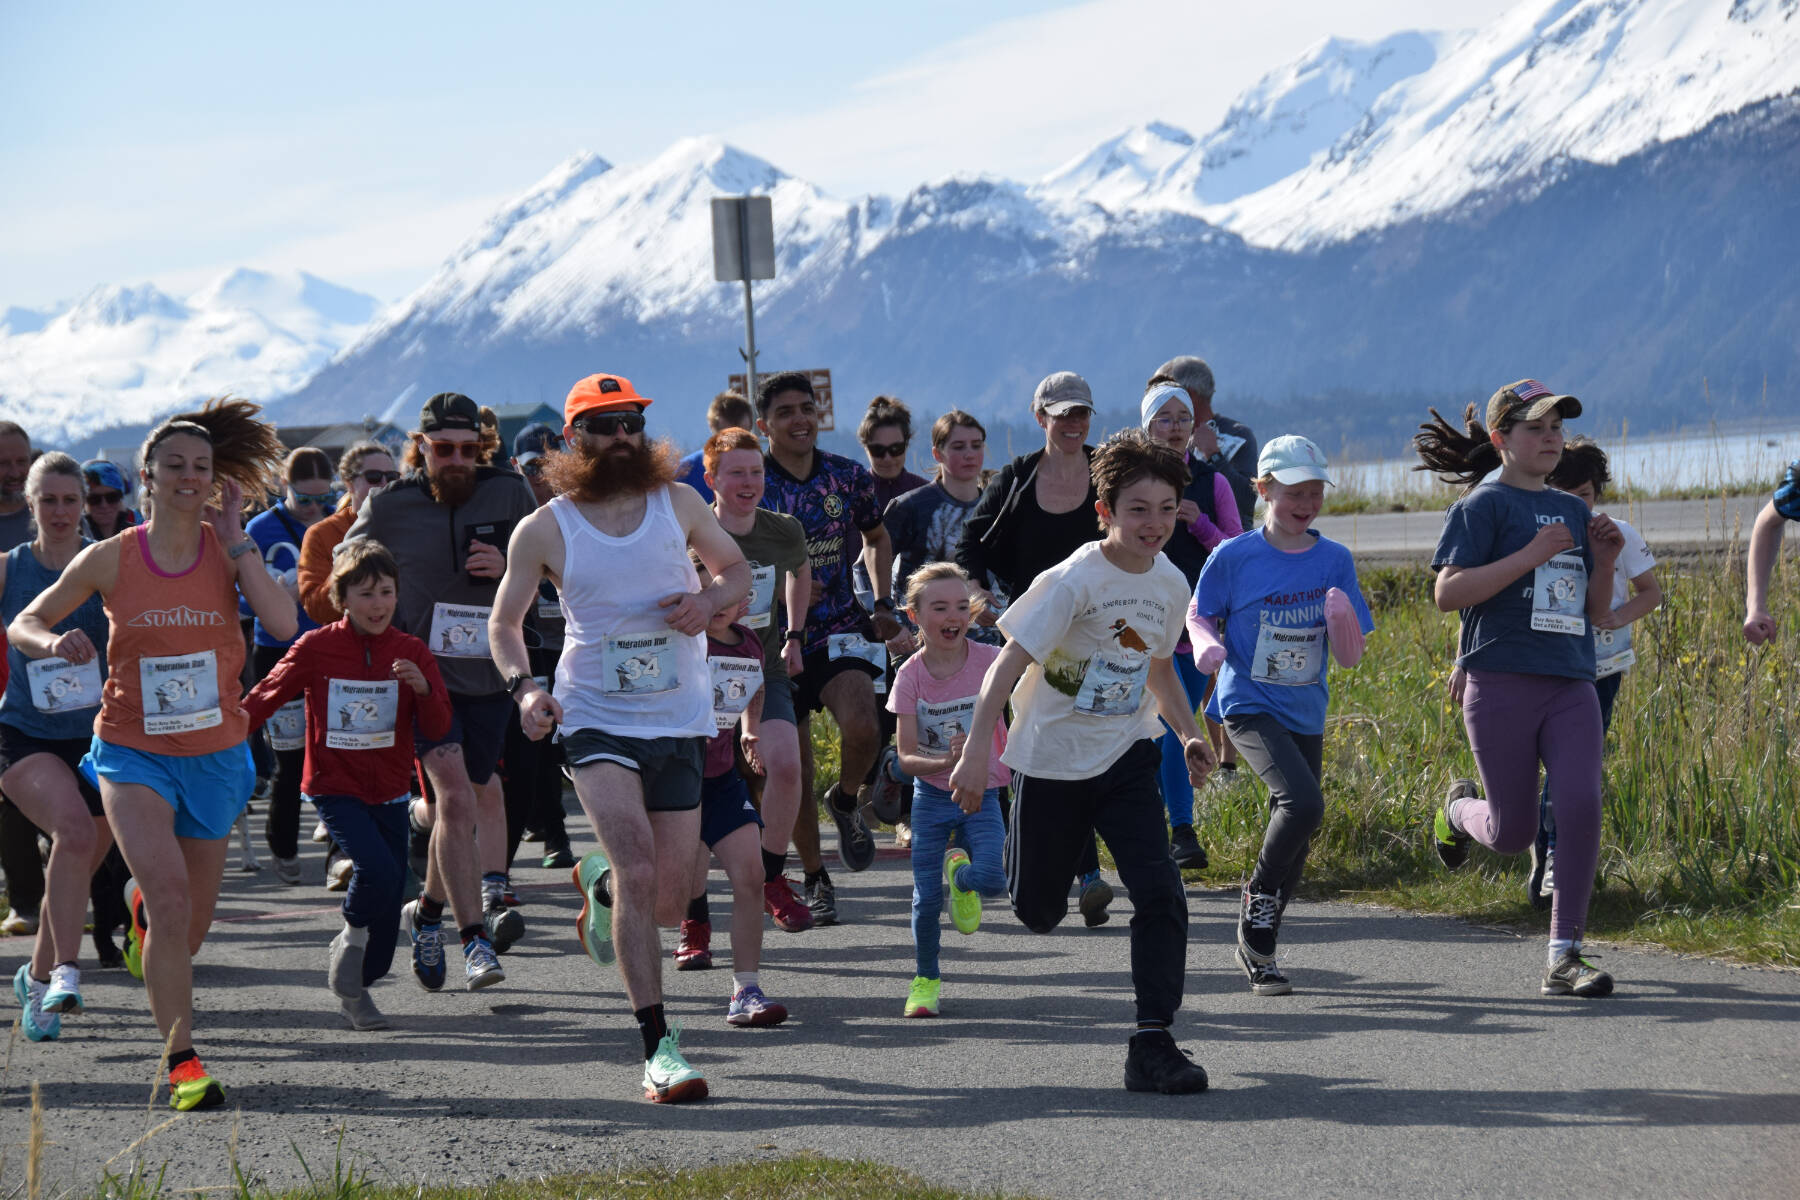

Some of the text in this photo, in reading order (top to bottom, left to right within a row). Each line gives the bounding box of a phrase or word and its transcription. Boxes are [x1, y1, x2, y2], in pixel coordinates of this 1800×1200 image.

[1554, 579, 1577, 602] 62
[143, 607, 216, 627] SUMMIT
[1259, 602, 1325, 626] RUNNIN
[449, 626, 478, 645] 67
[617, 639, 653, 649] Migration
[624, 656, 661, 680] 34
[1274, 651, 1308, 671] 55
[50, 676, 83, 698] 64
[164, 675, 195, 702] 31
[727, 680, 741, 700] 6
[347, 702, 379, 721] 72
